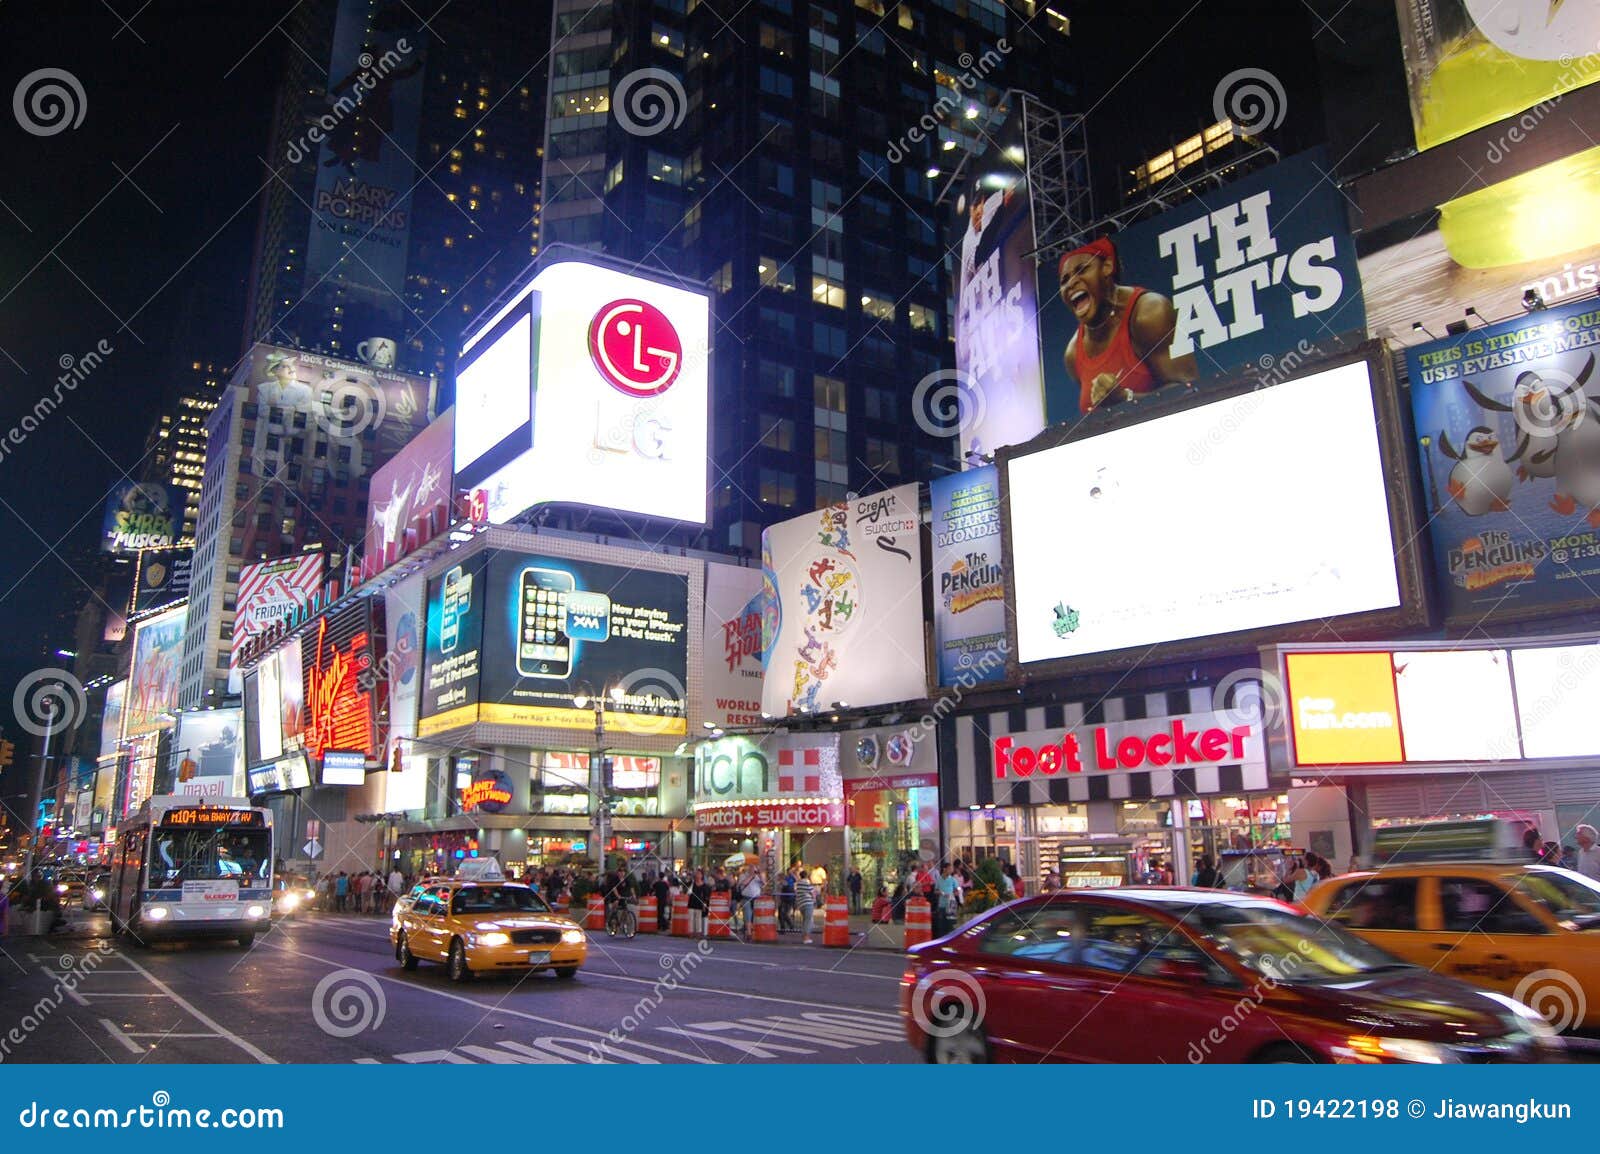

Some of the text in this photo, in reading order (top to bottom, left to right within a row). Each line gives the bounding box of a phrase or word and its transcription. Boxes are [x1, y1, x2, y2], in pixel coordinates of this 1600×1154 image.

[334, 180, 395, 208] MARY
[318, 192, 405, 228] POPPINS
[1158, 190, 1278, 290] TH
[1520, 263, 1600, 302] mis
[1169, 236, 1343, 360] AT'S
[1418, 345, 1463, 368] THIS
[1466, 341, 1484, 356] IS
[1486, 327, 1547, 352] TIMES
[1420, 363, 1460, 386] USE
[1463, 343, 1551, 376] EVASIVE
[856, 494, 896, 523] CreArt
[949, 508, 999, 531] STARTS
[113, 511, 176, 535] SHREK
[865, 520, 905, 536] swatch
[937, 522, 1000, 548] MONDA
[1480, 531, 1508, 546] The
[966, 551, 988, 568] The
[1450, 541, 1545, 573] PENGUINS
[569, 601, 605, 618] SIRIUS
[611, 603, 669, 621] Now playing
[573, 615, 600, 630] XM
[611, 616, 625, 626] on
[626, 618, 649, 629] your
[611, 625, 620, 637] &
[307, 616, 349, 756] Virgin
[716, 698, 761, 712] WORLD
[994, 719, 1251, 779] Foot Locker
[183, 779, 225, 797] maxell
[463, 780, 496, 801] PLANET
[463, 790, 512, 813] HOLLYWOOD
[171, 810, 197, 824] M104
